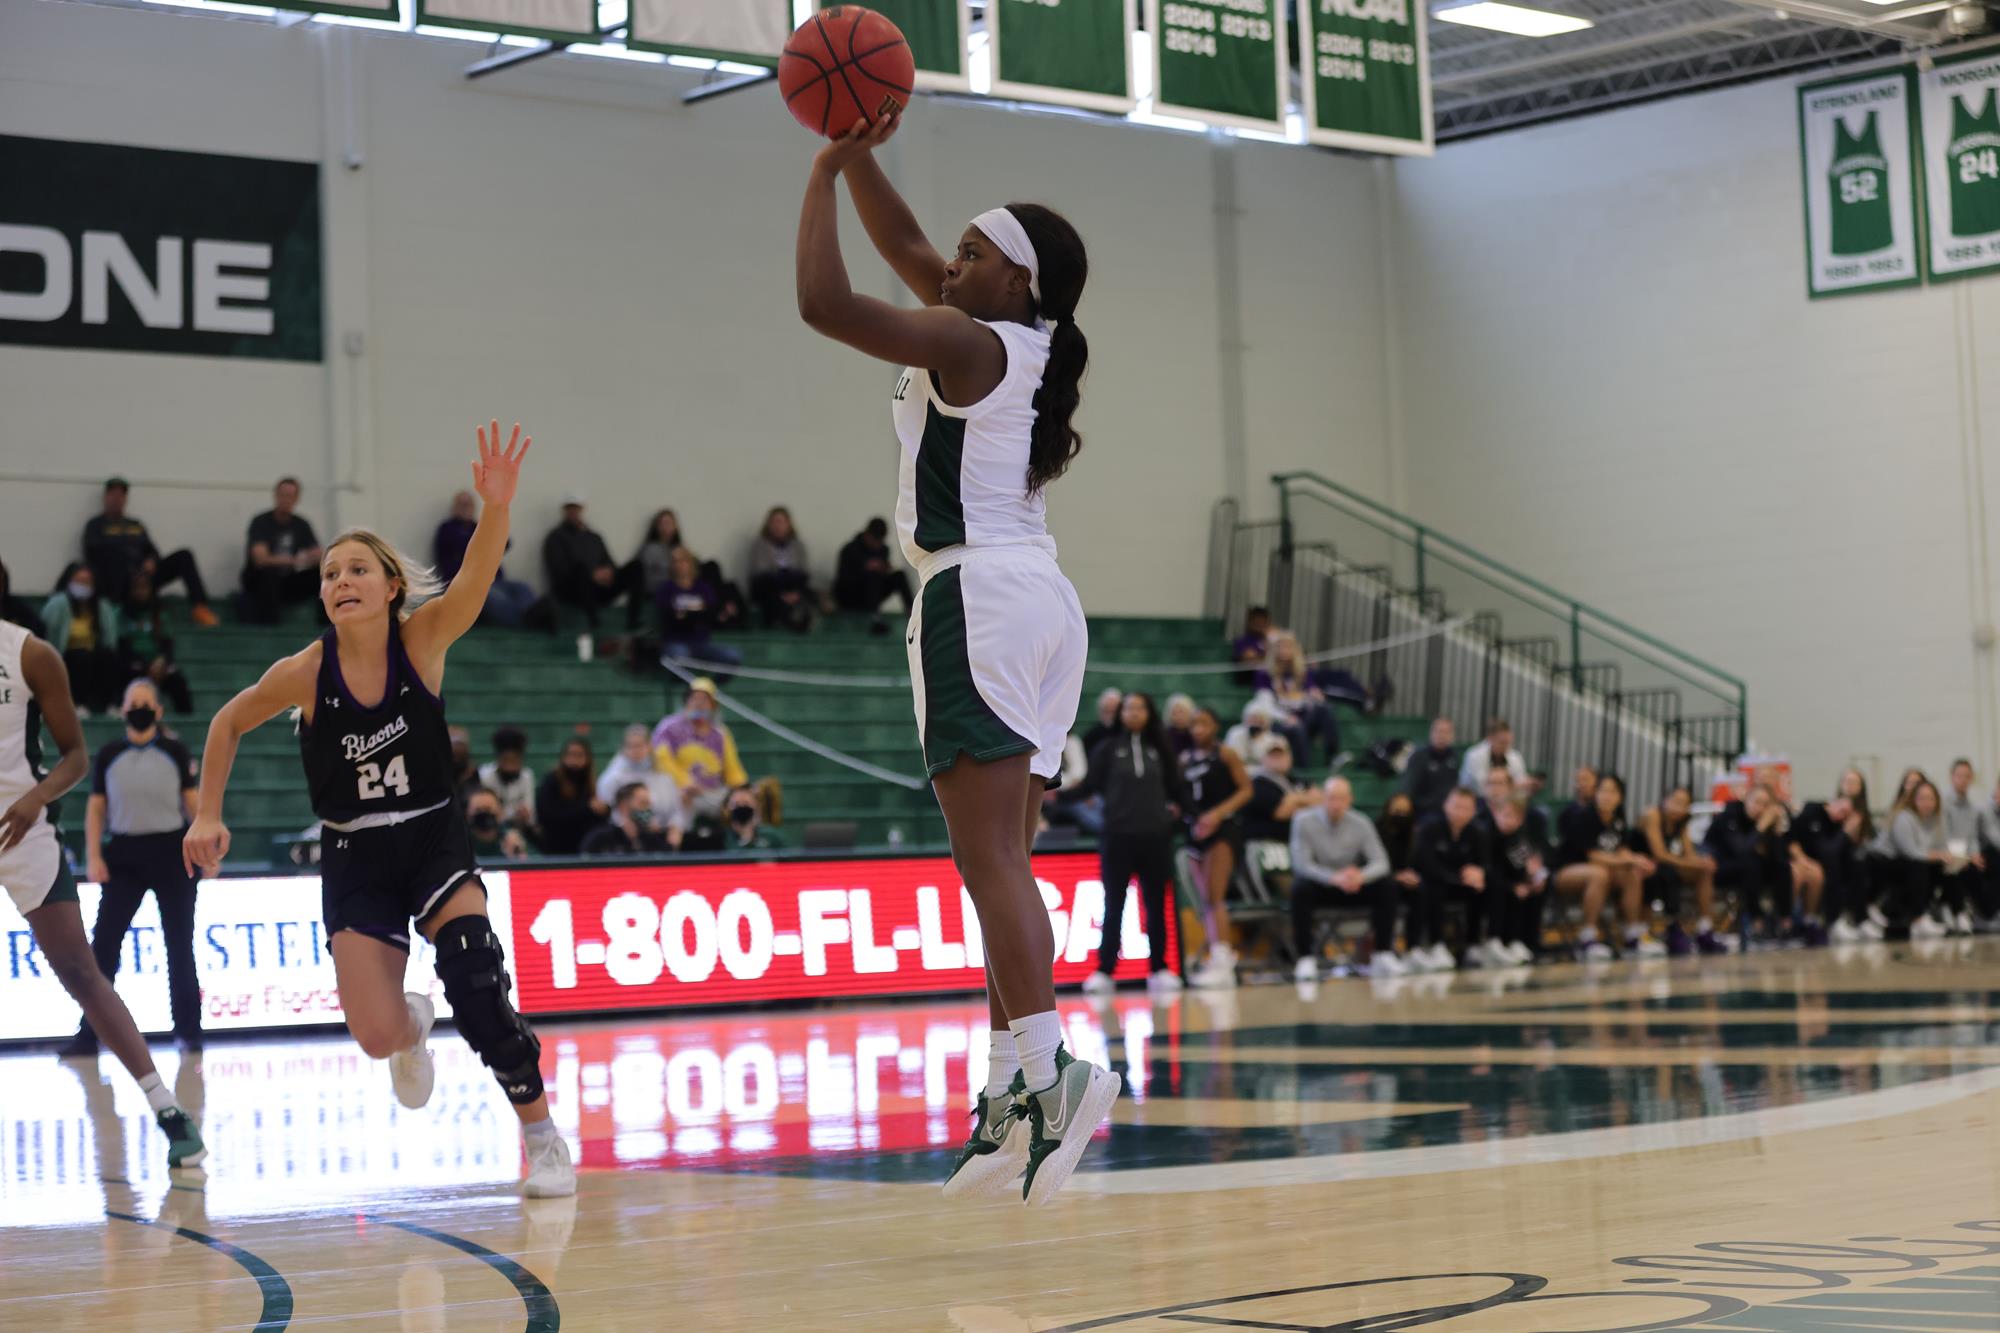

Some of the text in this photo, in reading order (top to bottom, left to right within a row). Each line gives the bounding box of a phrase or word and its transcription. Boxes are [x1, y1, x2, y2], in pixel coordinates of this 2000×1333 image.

[1958, 148, 2000, 184] 24
[0, 223, 273, 336] ONE
[341, 715, 408, 762] Bisons
[356, 754, 410, 800] 24
